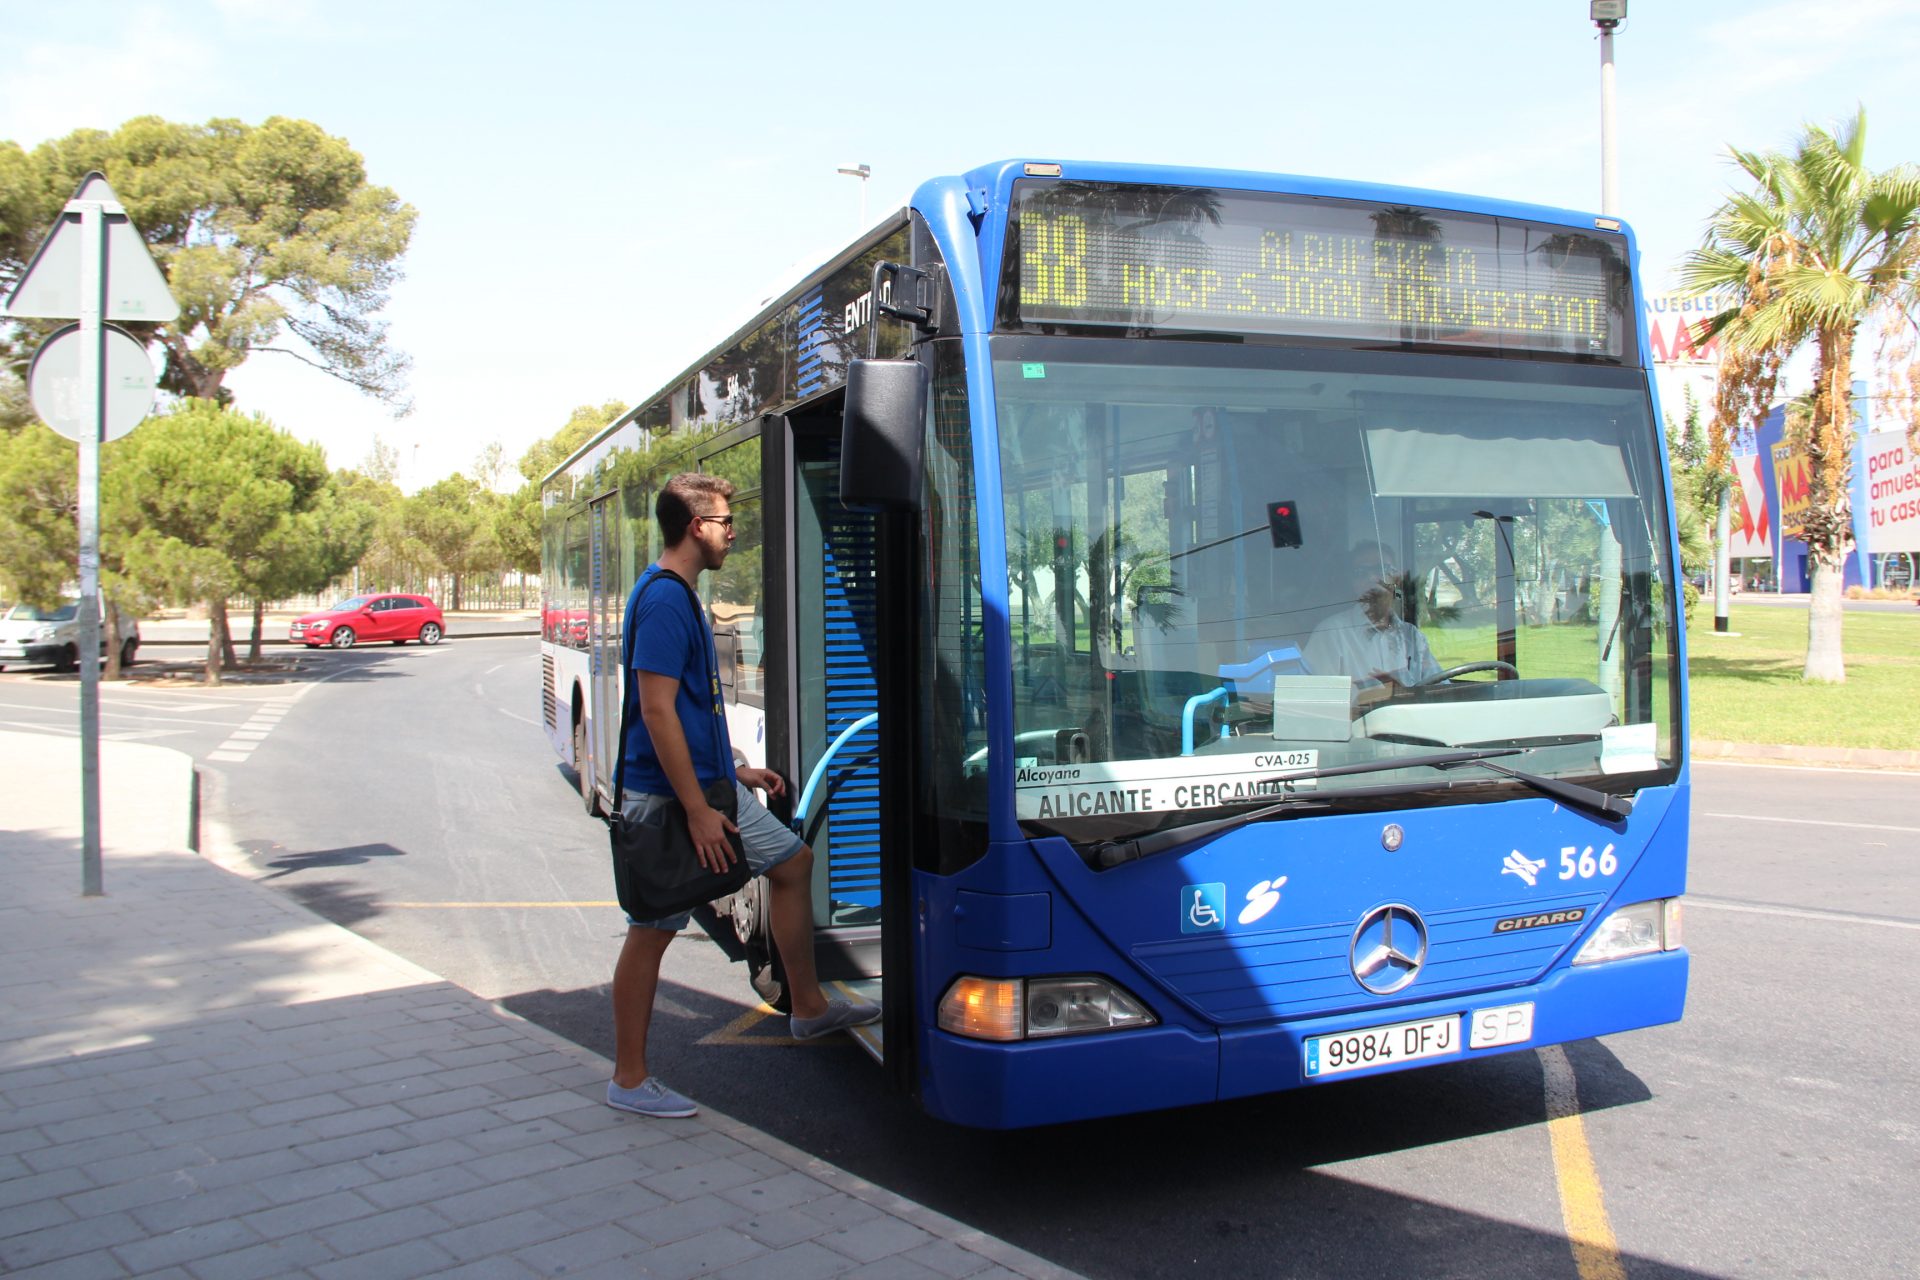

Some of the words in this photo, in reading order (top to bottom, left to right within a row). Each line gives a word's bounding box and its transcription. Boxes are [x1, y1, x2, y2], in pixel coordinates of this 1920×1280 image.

[1019, 212, 1087, 306] 38
[1868, 447, 1904, 480] para
[1871, 504, 1886, 528] tu
[1254, 752, 1311, 768] CVA-025
[1016, 768, 1081, 785] Alcoyana
[1038, 788, 1153, 820] ALICANTE
[1558, 842, 1618, 881] 566
[1497, 910, 1583, 931] CITARO
[1481, 1009, 1523, 1042] SP
[1328, 1031, 1393, 1068] 9984
[1404, 1021, 1451, 1056] DFJ
